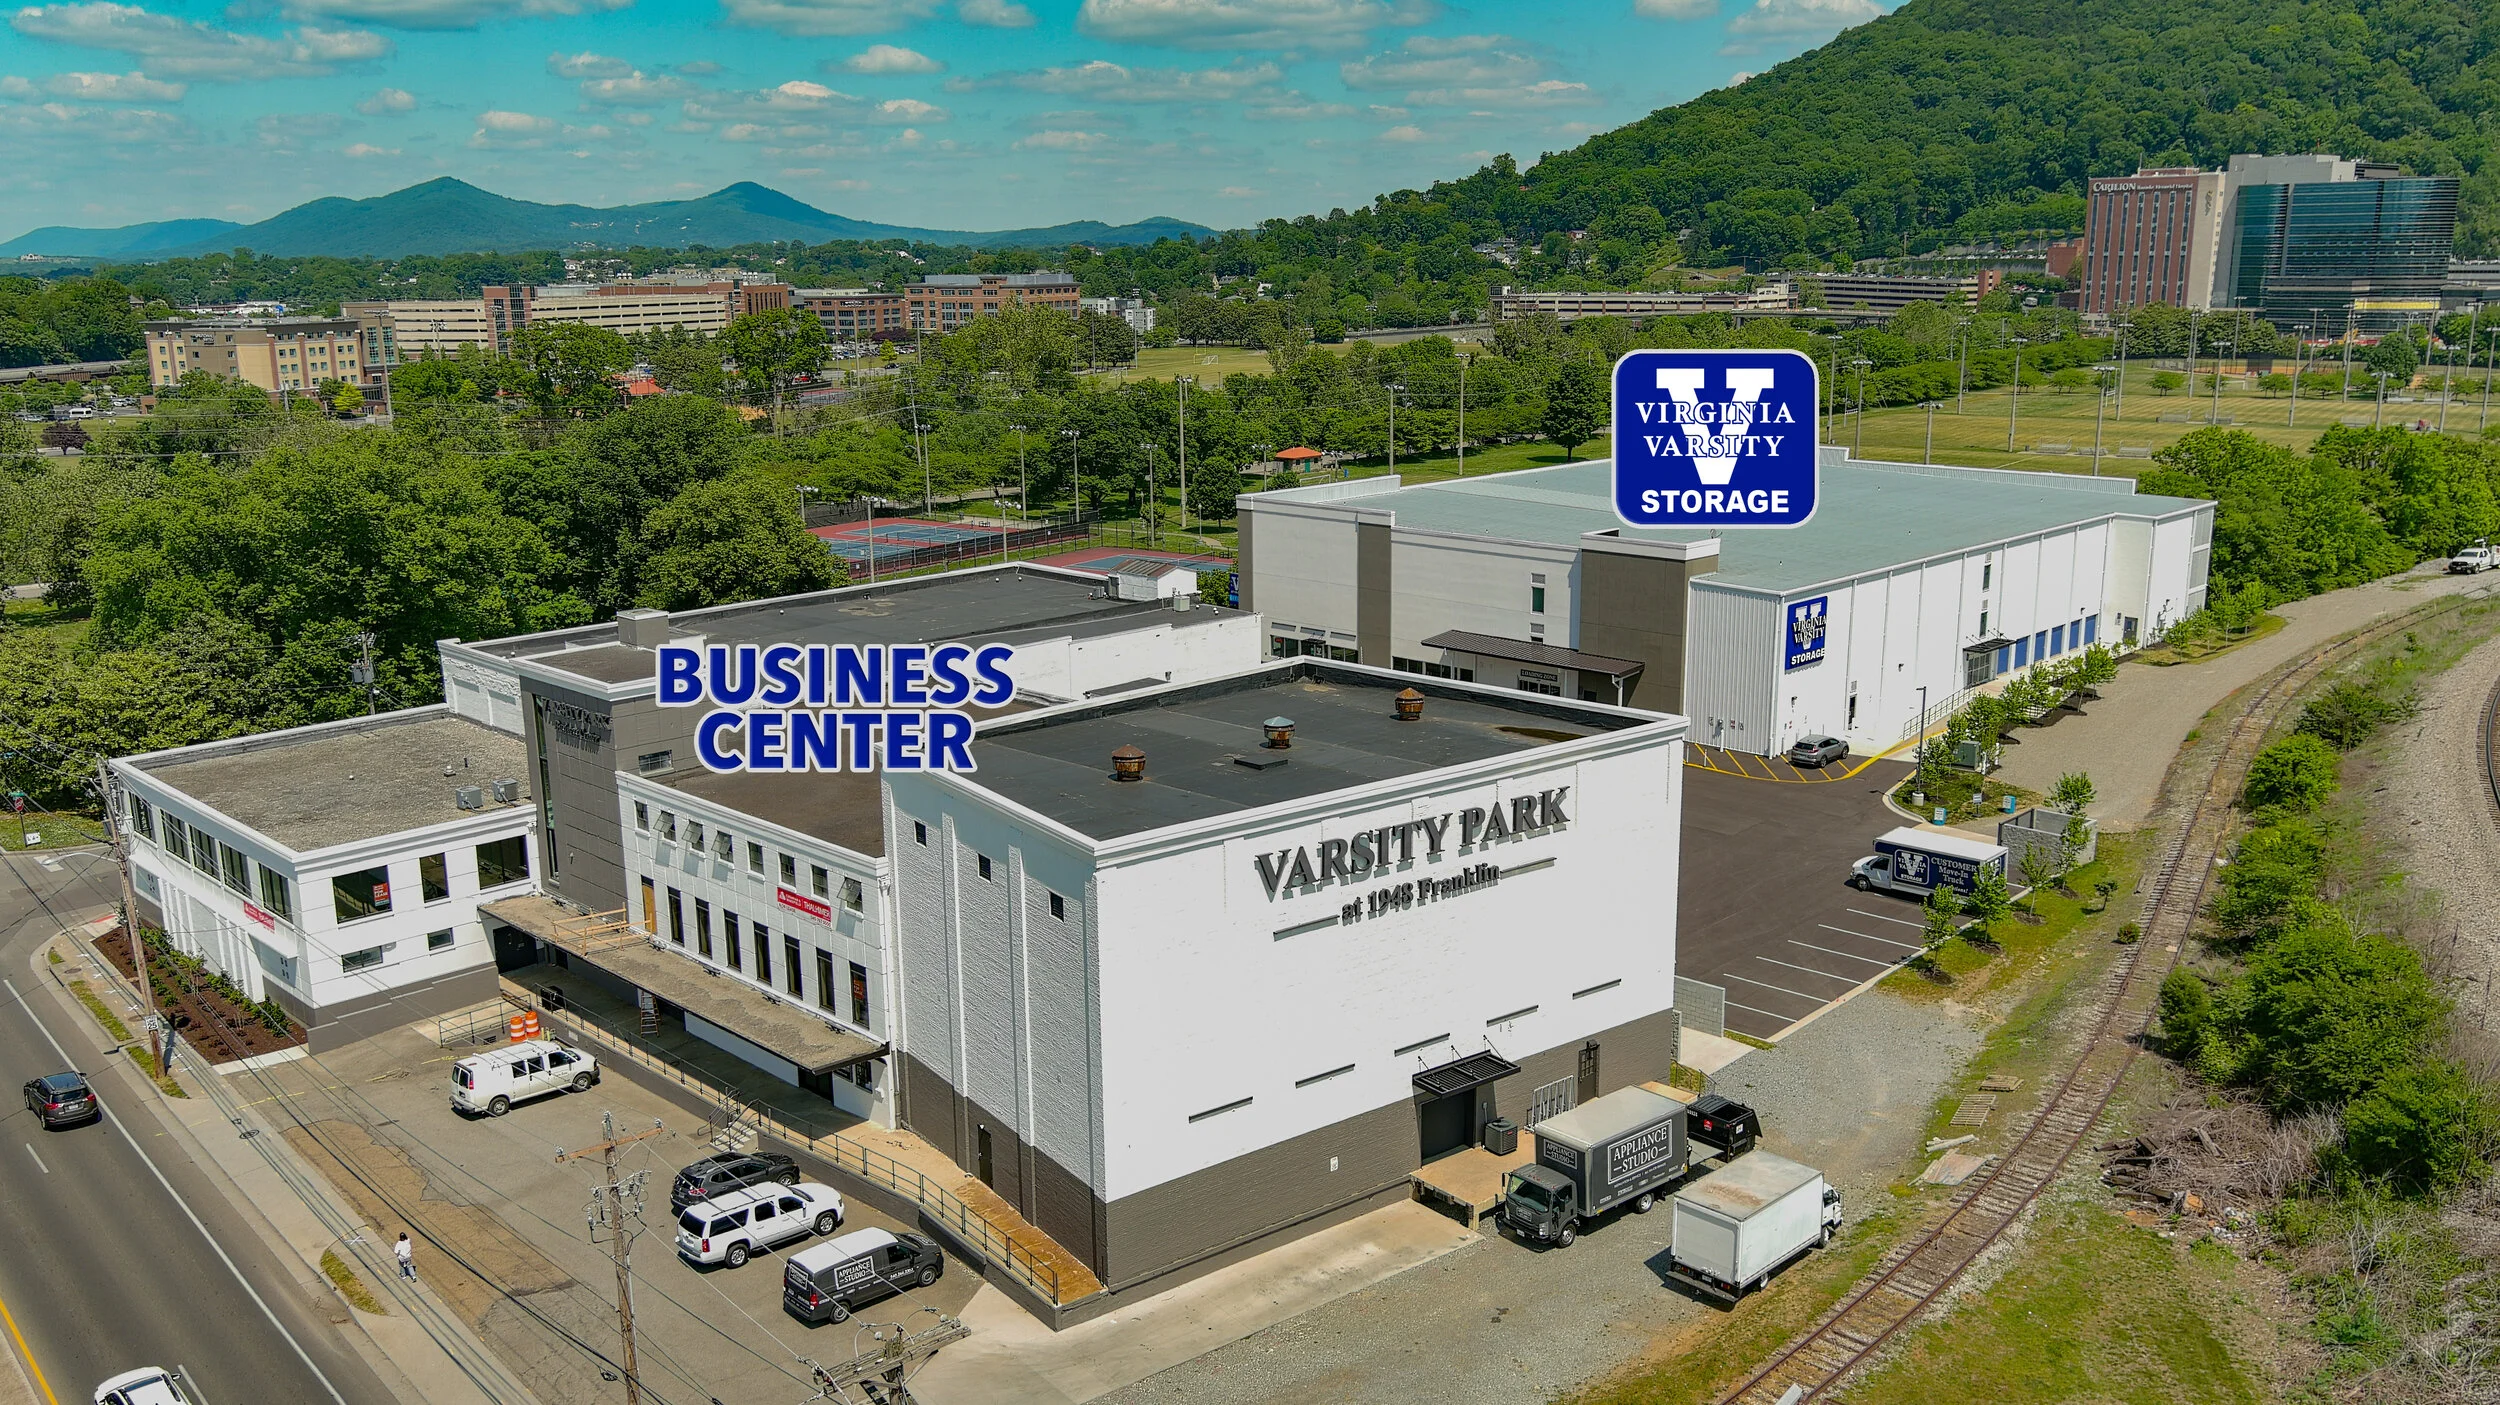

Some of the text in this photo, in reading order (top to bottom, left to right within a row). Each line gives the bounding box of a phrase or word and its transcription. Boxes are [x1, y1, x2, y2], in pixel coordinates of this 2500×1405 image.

[2093, 182, 2136, 192] CARILION
[1792, 614, 1827, 633] VIRGINIA
[1794, 626, 1825, 644] VARSITY
[1791, 648, 1826, 665] STORAGE
[1254, 786, 1570, 894] VARSITY PARK
[1931, 857, 1978, 872] CUSTOMER
[1939, 866, 1969, 878] Move-In
[1943, 874, 1965, 885] Truck
[1341, 862, 1500, 920] at 1948 Franklin
[148, 1021, 158, 1029] 25
[1546, 1143, 1575, 1159] APPLIANCE
[1613, 1127, 1667, 1161] APPLIANCE
[1551, 1151, 1570, 1164] STUDIO
[1622, 1146, 1659, 1172] STUDIO
[838, 1260, 871, 1279] APPLIANCE
[844, 1269, 867, 1283] STUDIO
